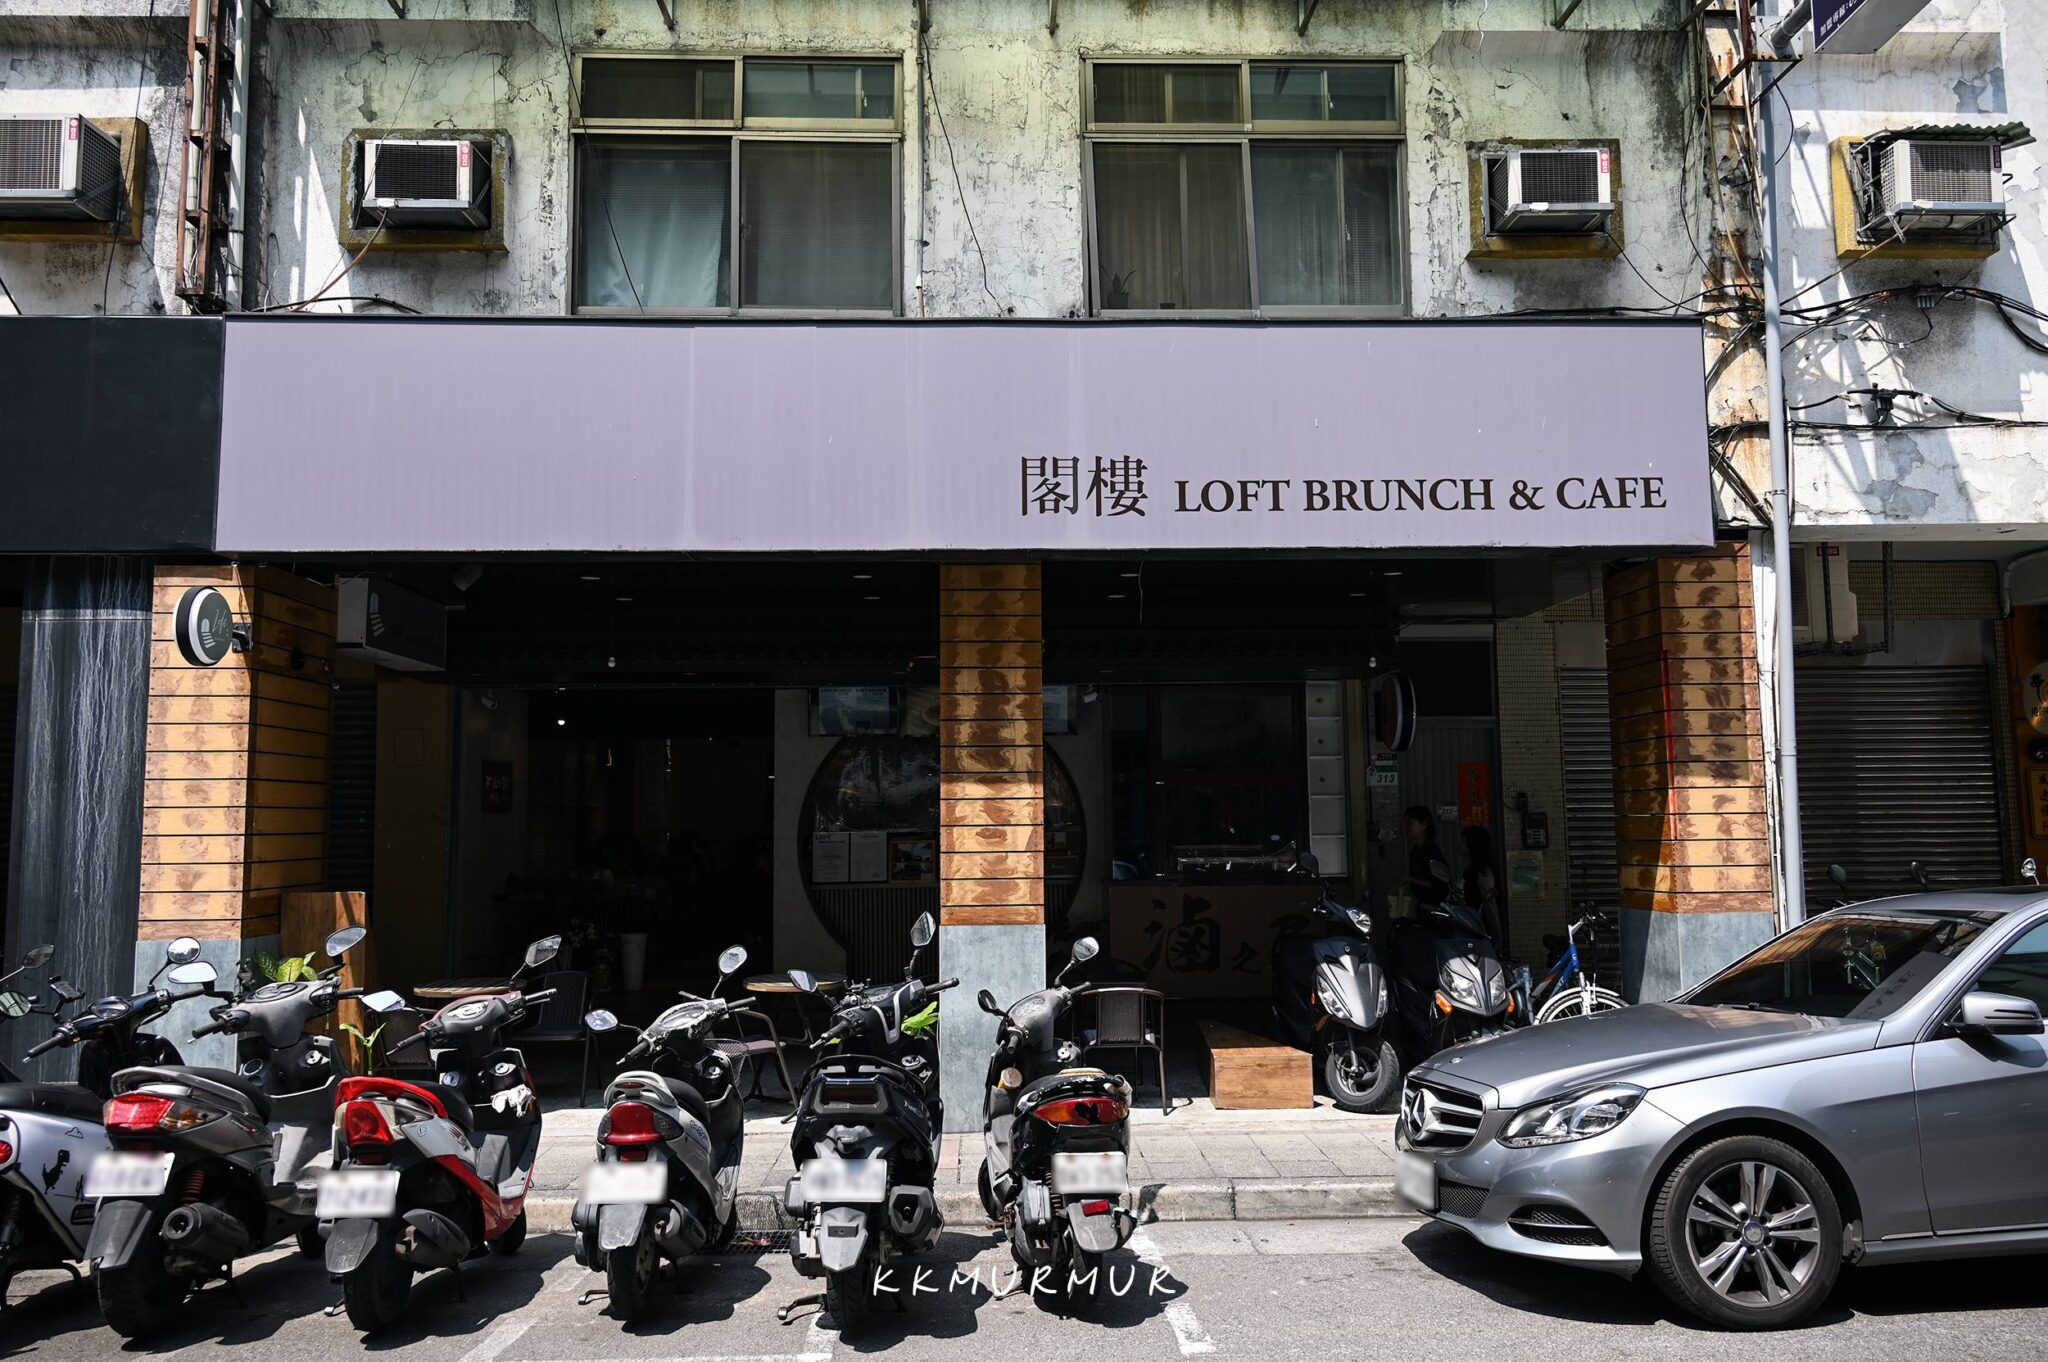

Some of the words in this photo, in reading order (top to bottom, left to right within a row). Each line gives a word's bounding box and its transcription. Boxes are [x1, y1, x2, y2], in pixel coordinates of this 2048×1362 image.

[1021, 455, 1149, 517] 閣樓
[1174, 479, 1291, 513] LOFT
[1302, 479, 1496, 512] BRUNCH
[1508, 479, 1545, 511] &
[1556, 477, 1667, 510] CAFE
[1377, 774, 1395, 784] 313
